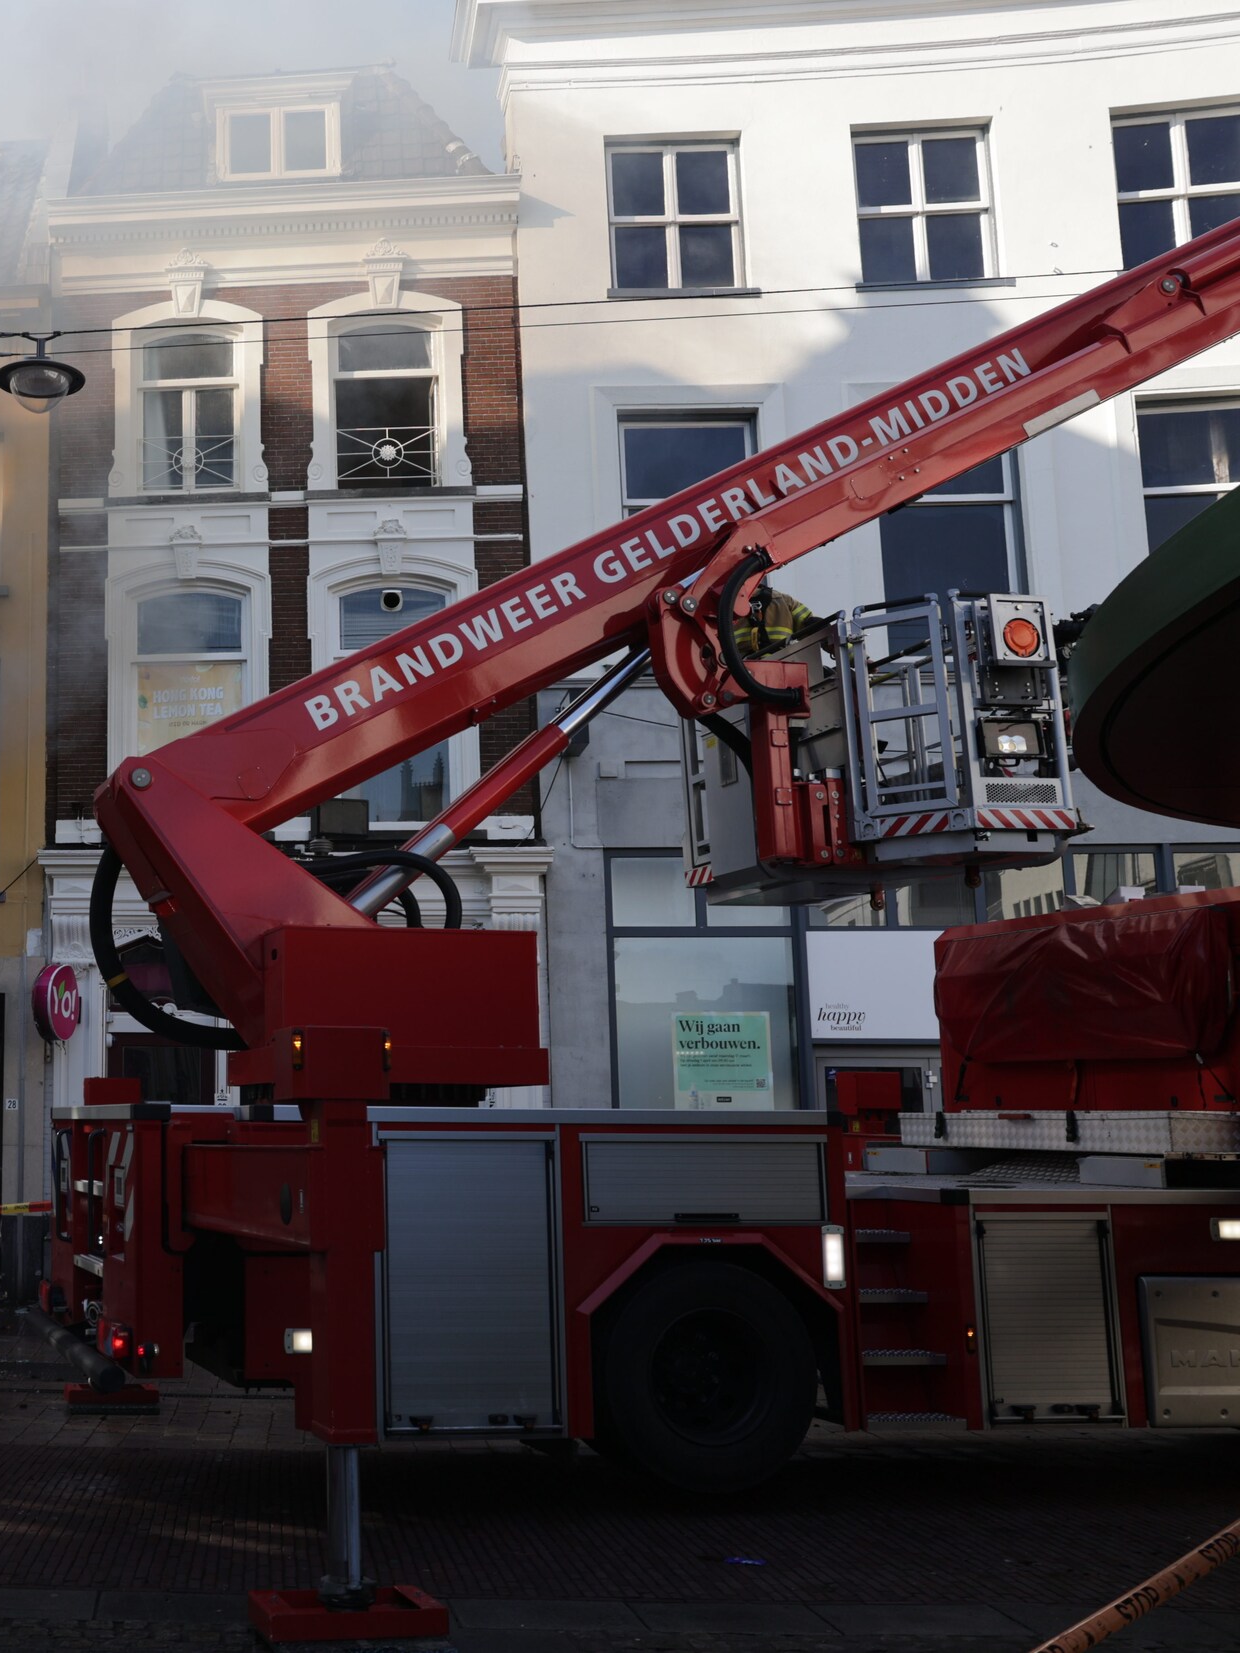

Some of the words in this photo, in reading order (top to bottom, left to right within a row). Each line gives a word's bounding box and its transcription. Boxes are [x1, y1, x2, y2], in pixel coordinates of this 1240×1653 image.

[305, 572, 587, 731] BRANDWEER
[592, 347, 1032, 584] GELDERLAND-MIDDEN
[153, 689, 187, 703] HONG
[190, 687, 224, 700] KONG
[153, 704, 196, 719] LEMON
[200, 703, 224, 717] TEA
[817, 1007, 866, 1025] happy
[679, 1020, 704, 1035] Wij
[707, 1023, 740, 1035] gaan
[679, 1037, 761, 1050] verbouwen.
[7, 1100, 17, 1109] 28
